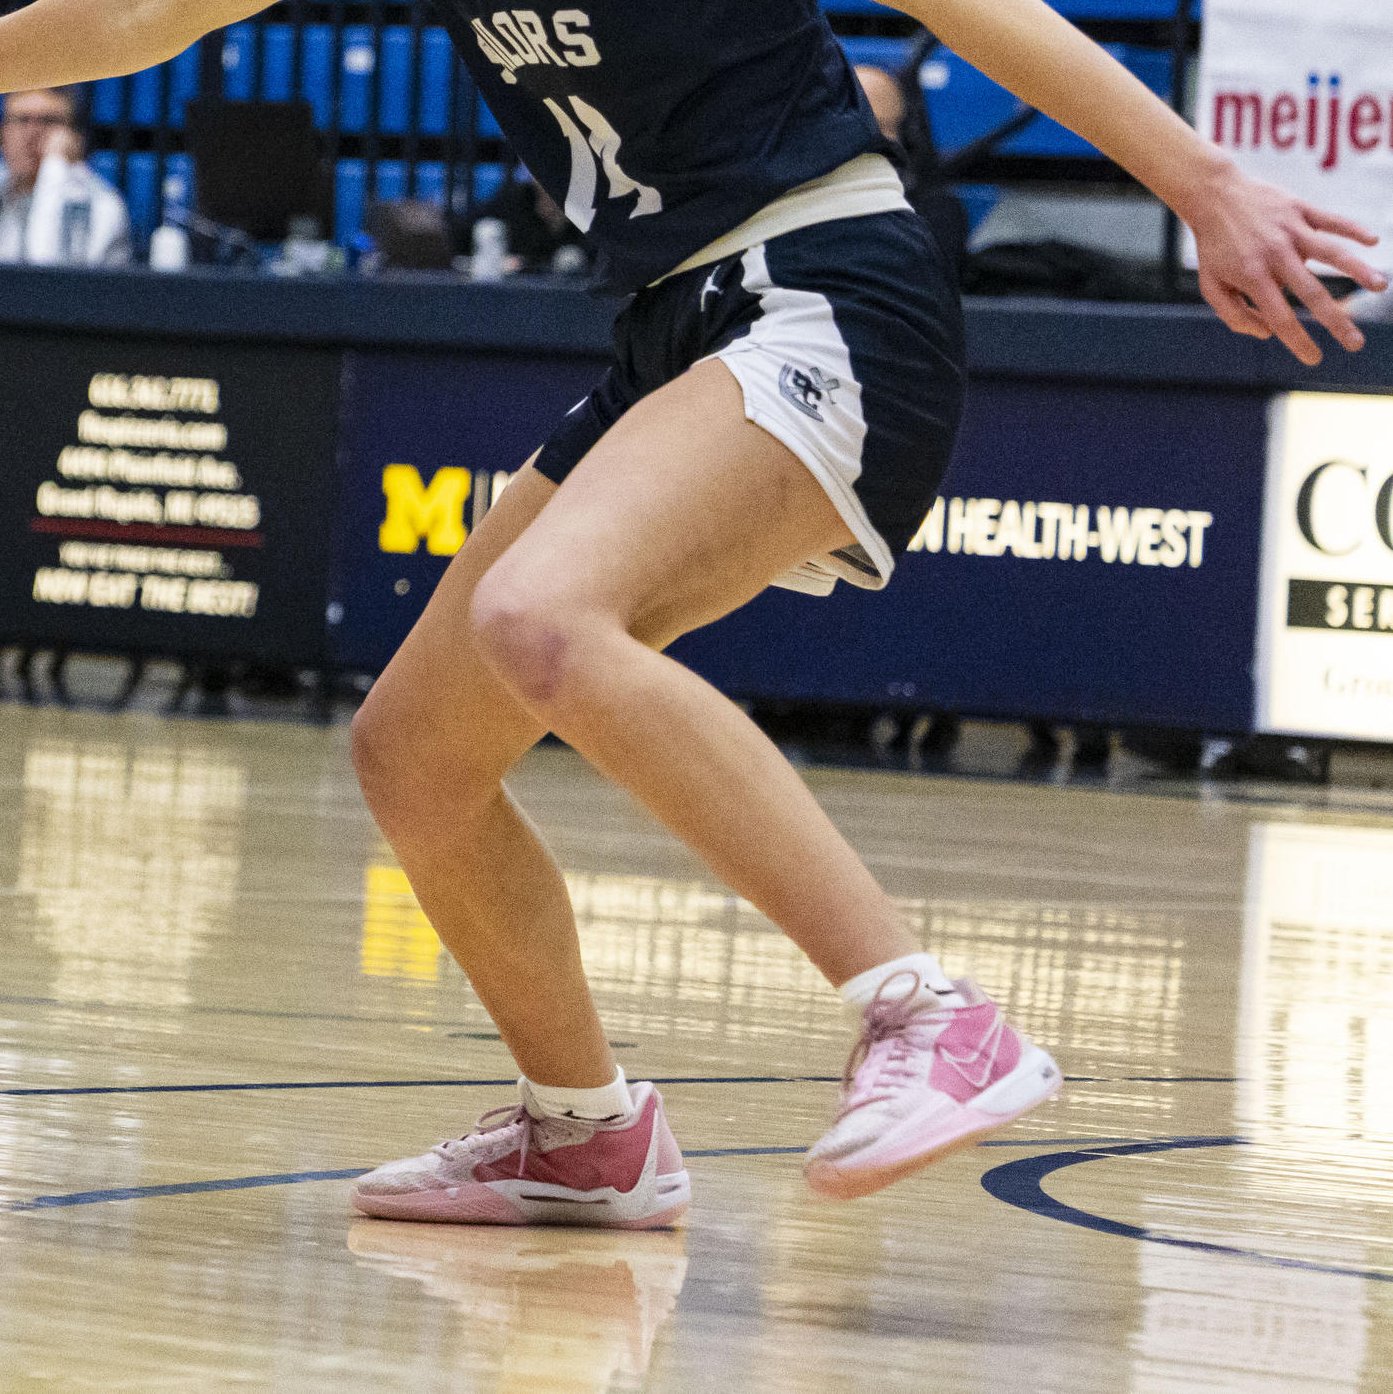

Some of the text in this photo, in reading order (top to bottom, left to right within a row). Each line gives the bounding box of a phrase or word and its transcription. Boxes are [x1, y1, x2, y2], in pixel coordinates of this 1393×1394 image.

[1213, 70, 1393, 168] meije
[379, 464, 471, 556] M
[946, 496, 1213, 568] HEALTH-WEST
[1296, 461, 1393, 556] C
